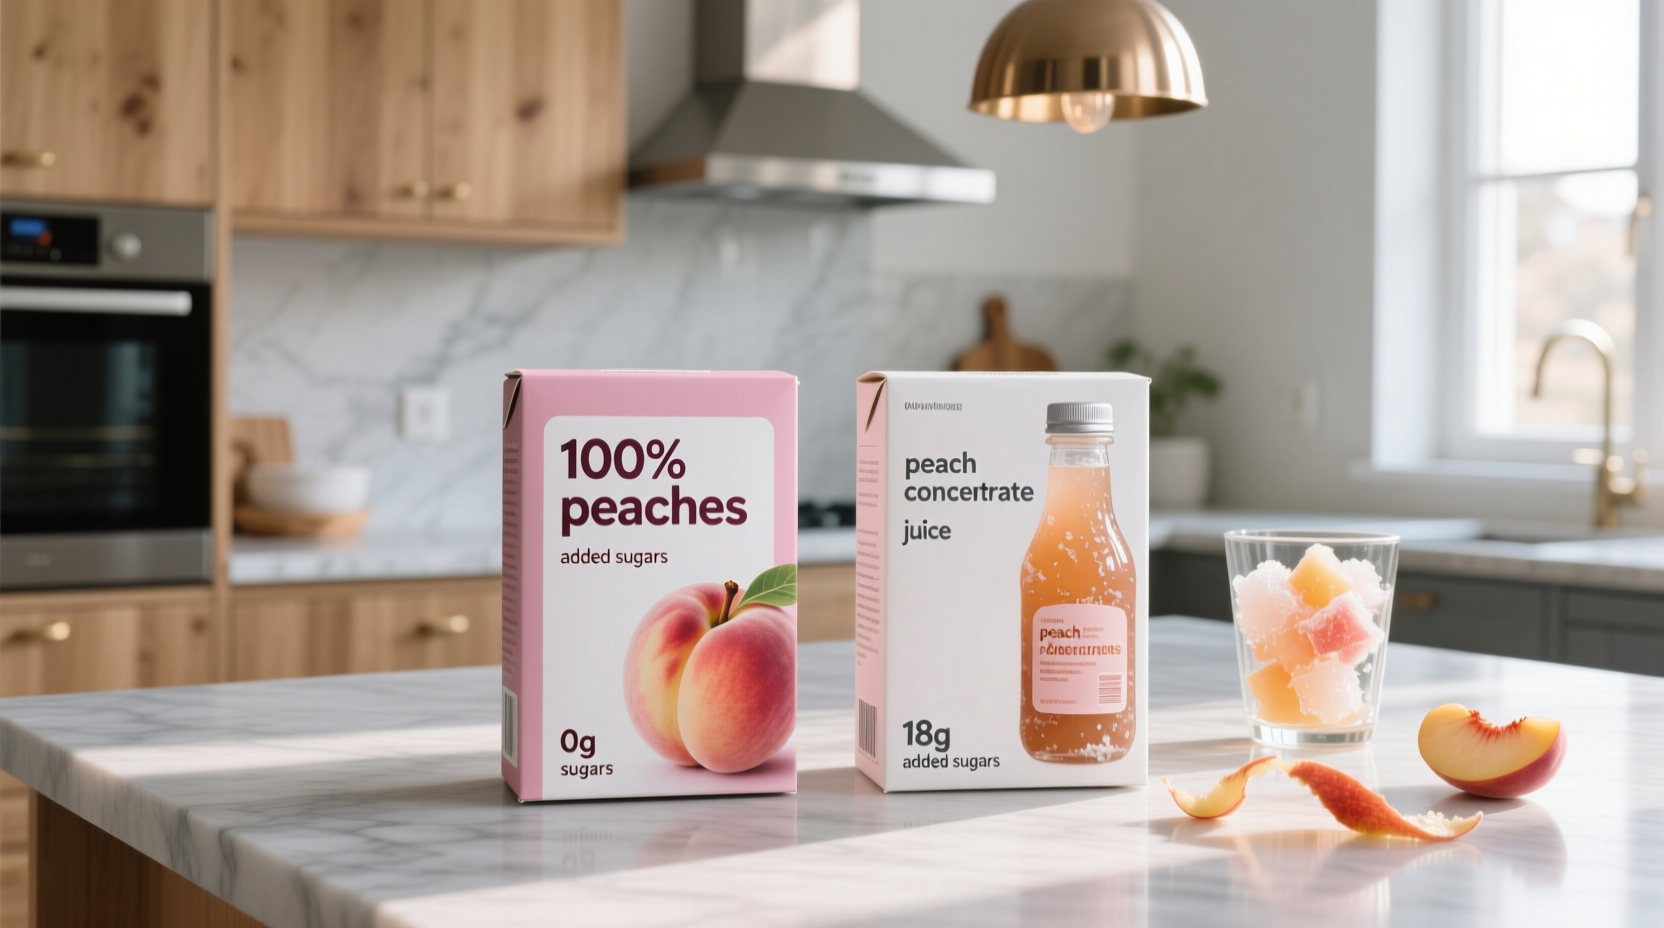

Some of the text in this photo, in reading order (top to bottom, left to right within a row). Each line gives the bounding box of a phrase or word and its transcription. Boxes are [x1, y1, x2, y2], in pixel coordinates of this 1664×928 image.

[560, 438, 687, 480] 100%
[905, 451, 977, 480] peach
[561, 484, 748, 537] peaches
[902, 519, 951, 546] juice
[560, 548, 669, 567] added sugars
[1040, 625, 1081, 641] peach
[560, 728, 596, 759] 0g
[902, 719, 951, 753] 18g
[560, 764, 614, 780] sugars
[902, 753, 1001, 772] added sugars
